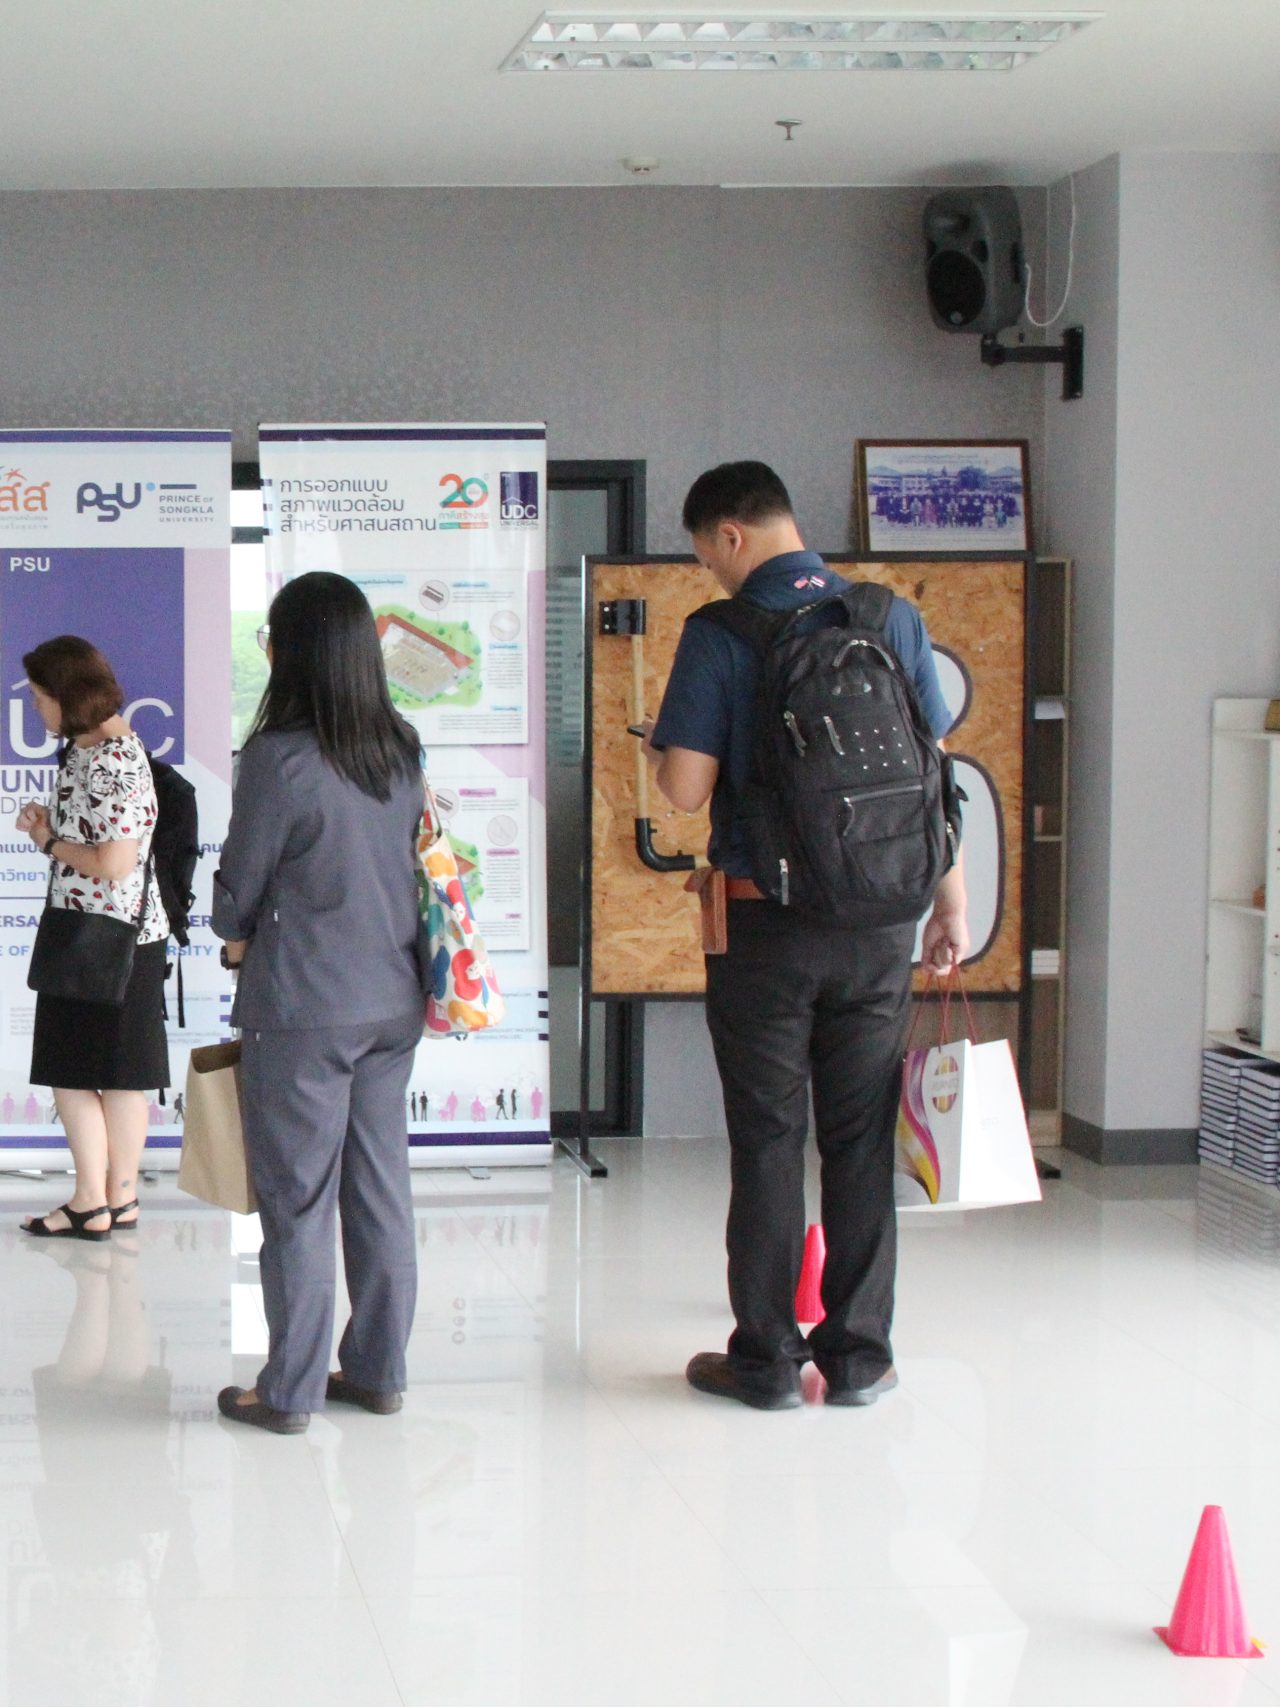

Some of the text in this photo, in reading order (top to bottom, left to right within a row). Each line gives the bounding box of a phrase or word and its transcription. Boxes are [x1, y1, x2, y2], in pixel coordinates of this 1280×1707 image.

[280, 479, 388, 493] การออกแบบ
[159, 495, 202, 503] PRINCE
[280, 493, 405, 513] สภาพแวดล้อม
[159, 506, 215, 514] SONGKLA
[501, 504, 537, 519] UDC
[280, 514, 437, 533] สำหรับศาสนสถาน
[9, 556, 51, 572] PSU
[8, 945, 31, 957] OF
